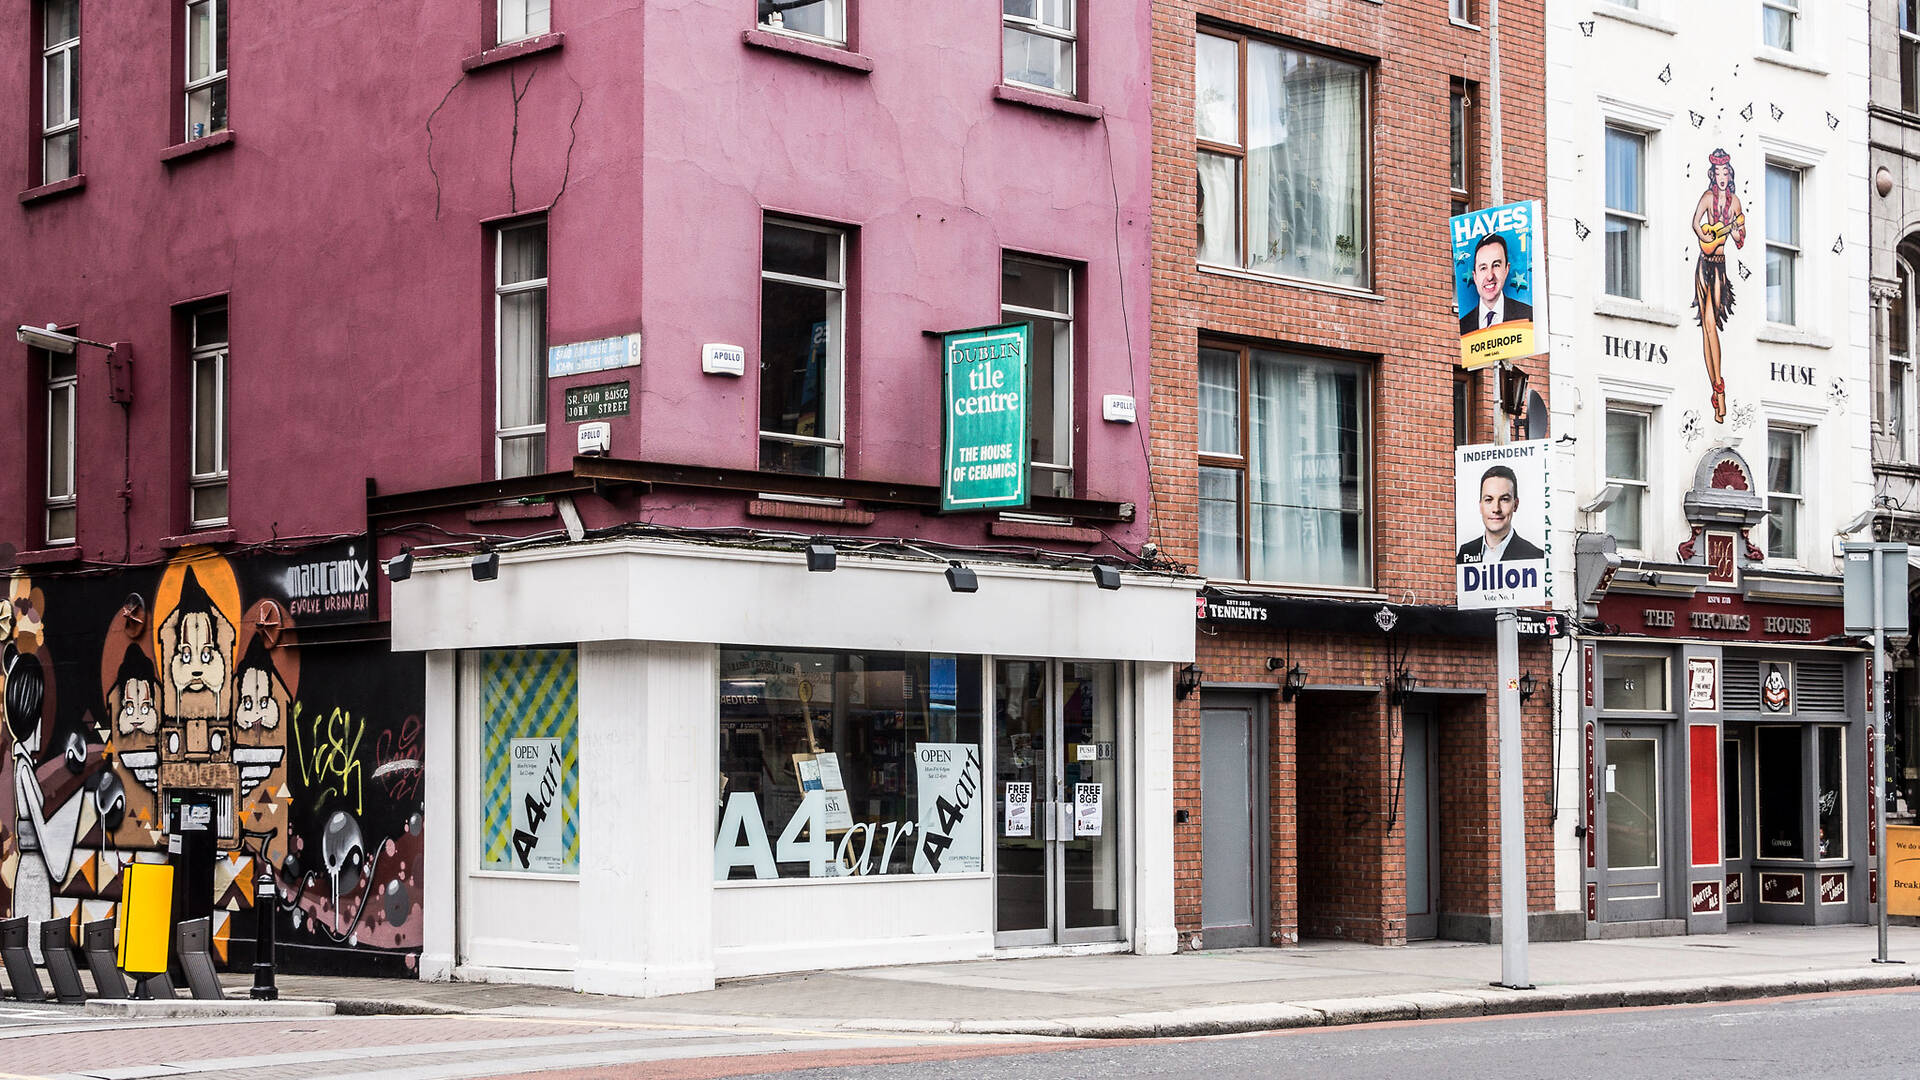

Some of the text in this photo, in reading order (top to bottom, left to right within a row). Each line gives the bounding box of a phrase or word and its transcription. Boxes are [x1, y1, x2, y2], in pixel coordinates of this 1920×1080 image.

[1454, 206, 1528, 243] HAYES
[1518, 233, 1527, 252] 1
[631, 342, 638, 357] 8
[952, 341, 1022, 364] DUBLIN
[1470, 334, 1523, 354] FOR EUROPE
[1602, 334, 1668, 365] THOMAS
[713, 351, 741, 362] APOLLO
[969, 361, 1004, 391] tile
[1770, 361, 1816, 387] HOUSE
[568, 401, 628, 417] JOHN STREET
[955, 391, 1019, 416] centre
[1112, 401, 1133, 410] APOLLO
[581, 430, 600, 440] APOLLO
[959, 443, 1012, 462] THE HOUSE
[1463, 446, 1535, 463] INDEPENDENT
[953, 462, 1017, 482] OF CERAMICS
[1463, 552, 1482, 563] Paul
[1463, 563, 1538, 592] Dillon
[290, 592, 369, 615] EVOLVE URBAN ART
[1483, 594, 1497, 602] Vote
[1209, 604, 1268, 621] TENNENT'S
[1517, 621, 1546, 634] NENT'S
[1644, 609, 1811, 634] THE THOMAS HOUSE
[720, 694, 759, 705] AEDTLER
[514, 745, 539, 759] OPEN
[921, 749, 952, 762] OPEN
[1008, 784, 1030, 794] FREE
[1077, 785, 1100, 794] FREE
[513, 742, 562, 869] A4art
[1010, 794, 1028, 803] 8GB
[1079, 794, 1098, 804] 8GB
[1692, 884, 1713, 908] PORTER
[1708, 893, 1719, 910] ALE
